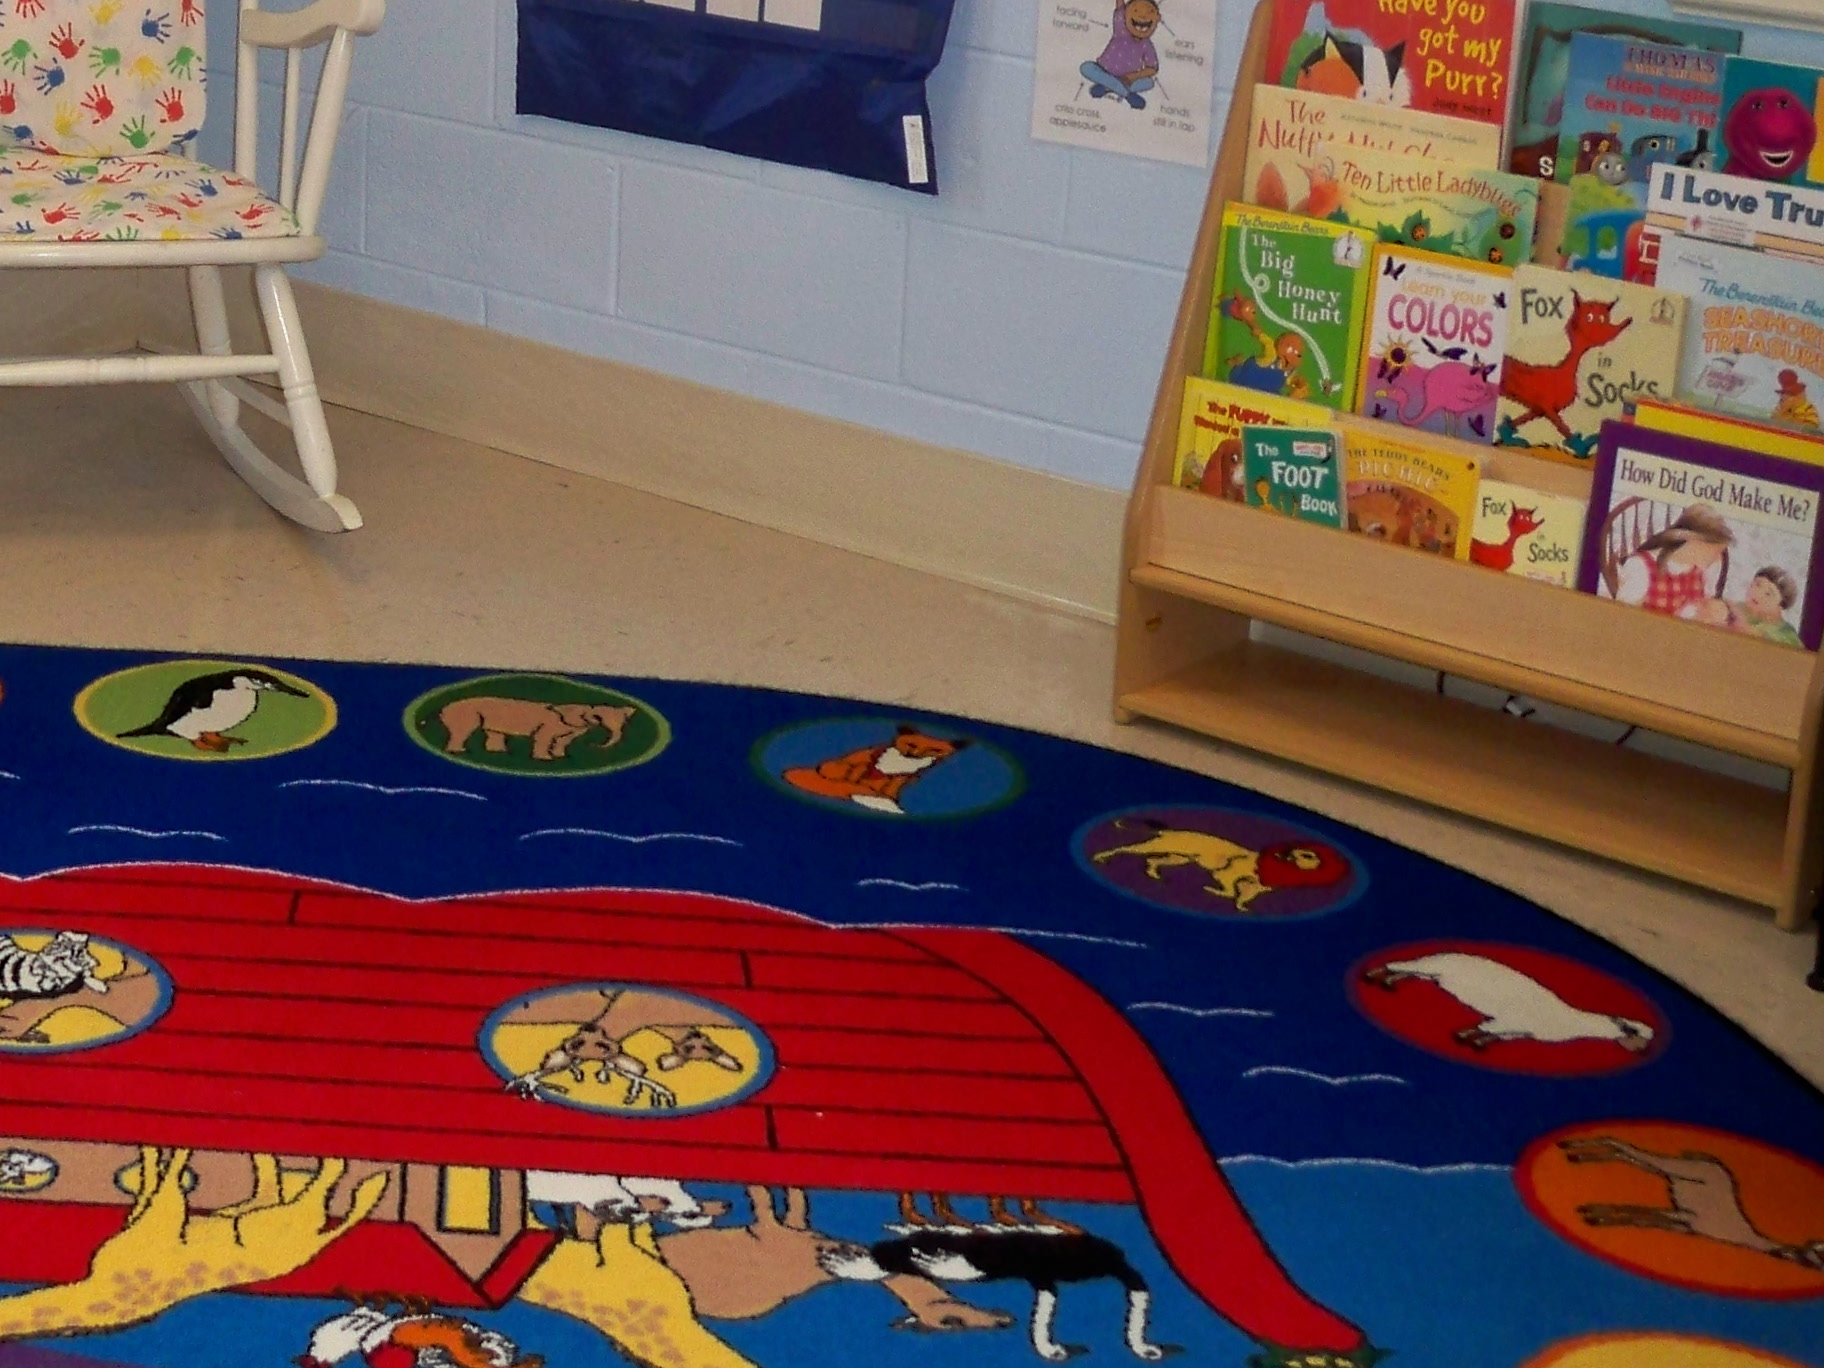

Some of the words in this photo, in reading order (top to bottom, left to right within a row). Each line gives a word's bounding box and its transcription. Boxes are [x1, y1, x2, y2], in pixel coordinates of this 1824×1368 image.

[1416, 24, 1460, 57] got
[1463, 37, 1502, 68] my
[1425, 59, 1503, 100] Purr?
[1285, 100, 1326, 124] The
[1343, 161, 1372, 191] Ten
[1377, 170, 1432, 194] Little
[1660, 172, 1675, 200] I
[1683, 175, 1759, 215] Love
[1260, 251, 1296, 279] Big
[1277, 279, 1342, 308] Honey
[1521, 288, 1564, 325] Fox
[1292, 302, 1342, 325] Hunt
[1388, 293, 1494, 348] COLORS
[1597, 352, 1612, 368] in
[1255, 443, 1278, 457] The
[1271, 461, 1329, 488] FOOT
[1621, 458, 1655, 484] How
[1659, 467, 1687, 494] Did
[1691, 475, 1723, 503] God
[1729, 482, 1773, 516] Make
[1777, 494, 1811, 522] Me?
[1482, 497, 1507, 517] Fox
[1528, 543, 1569, 563] Socks
